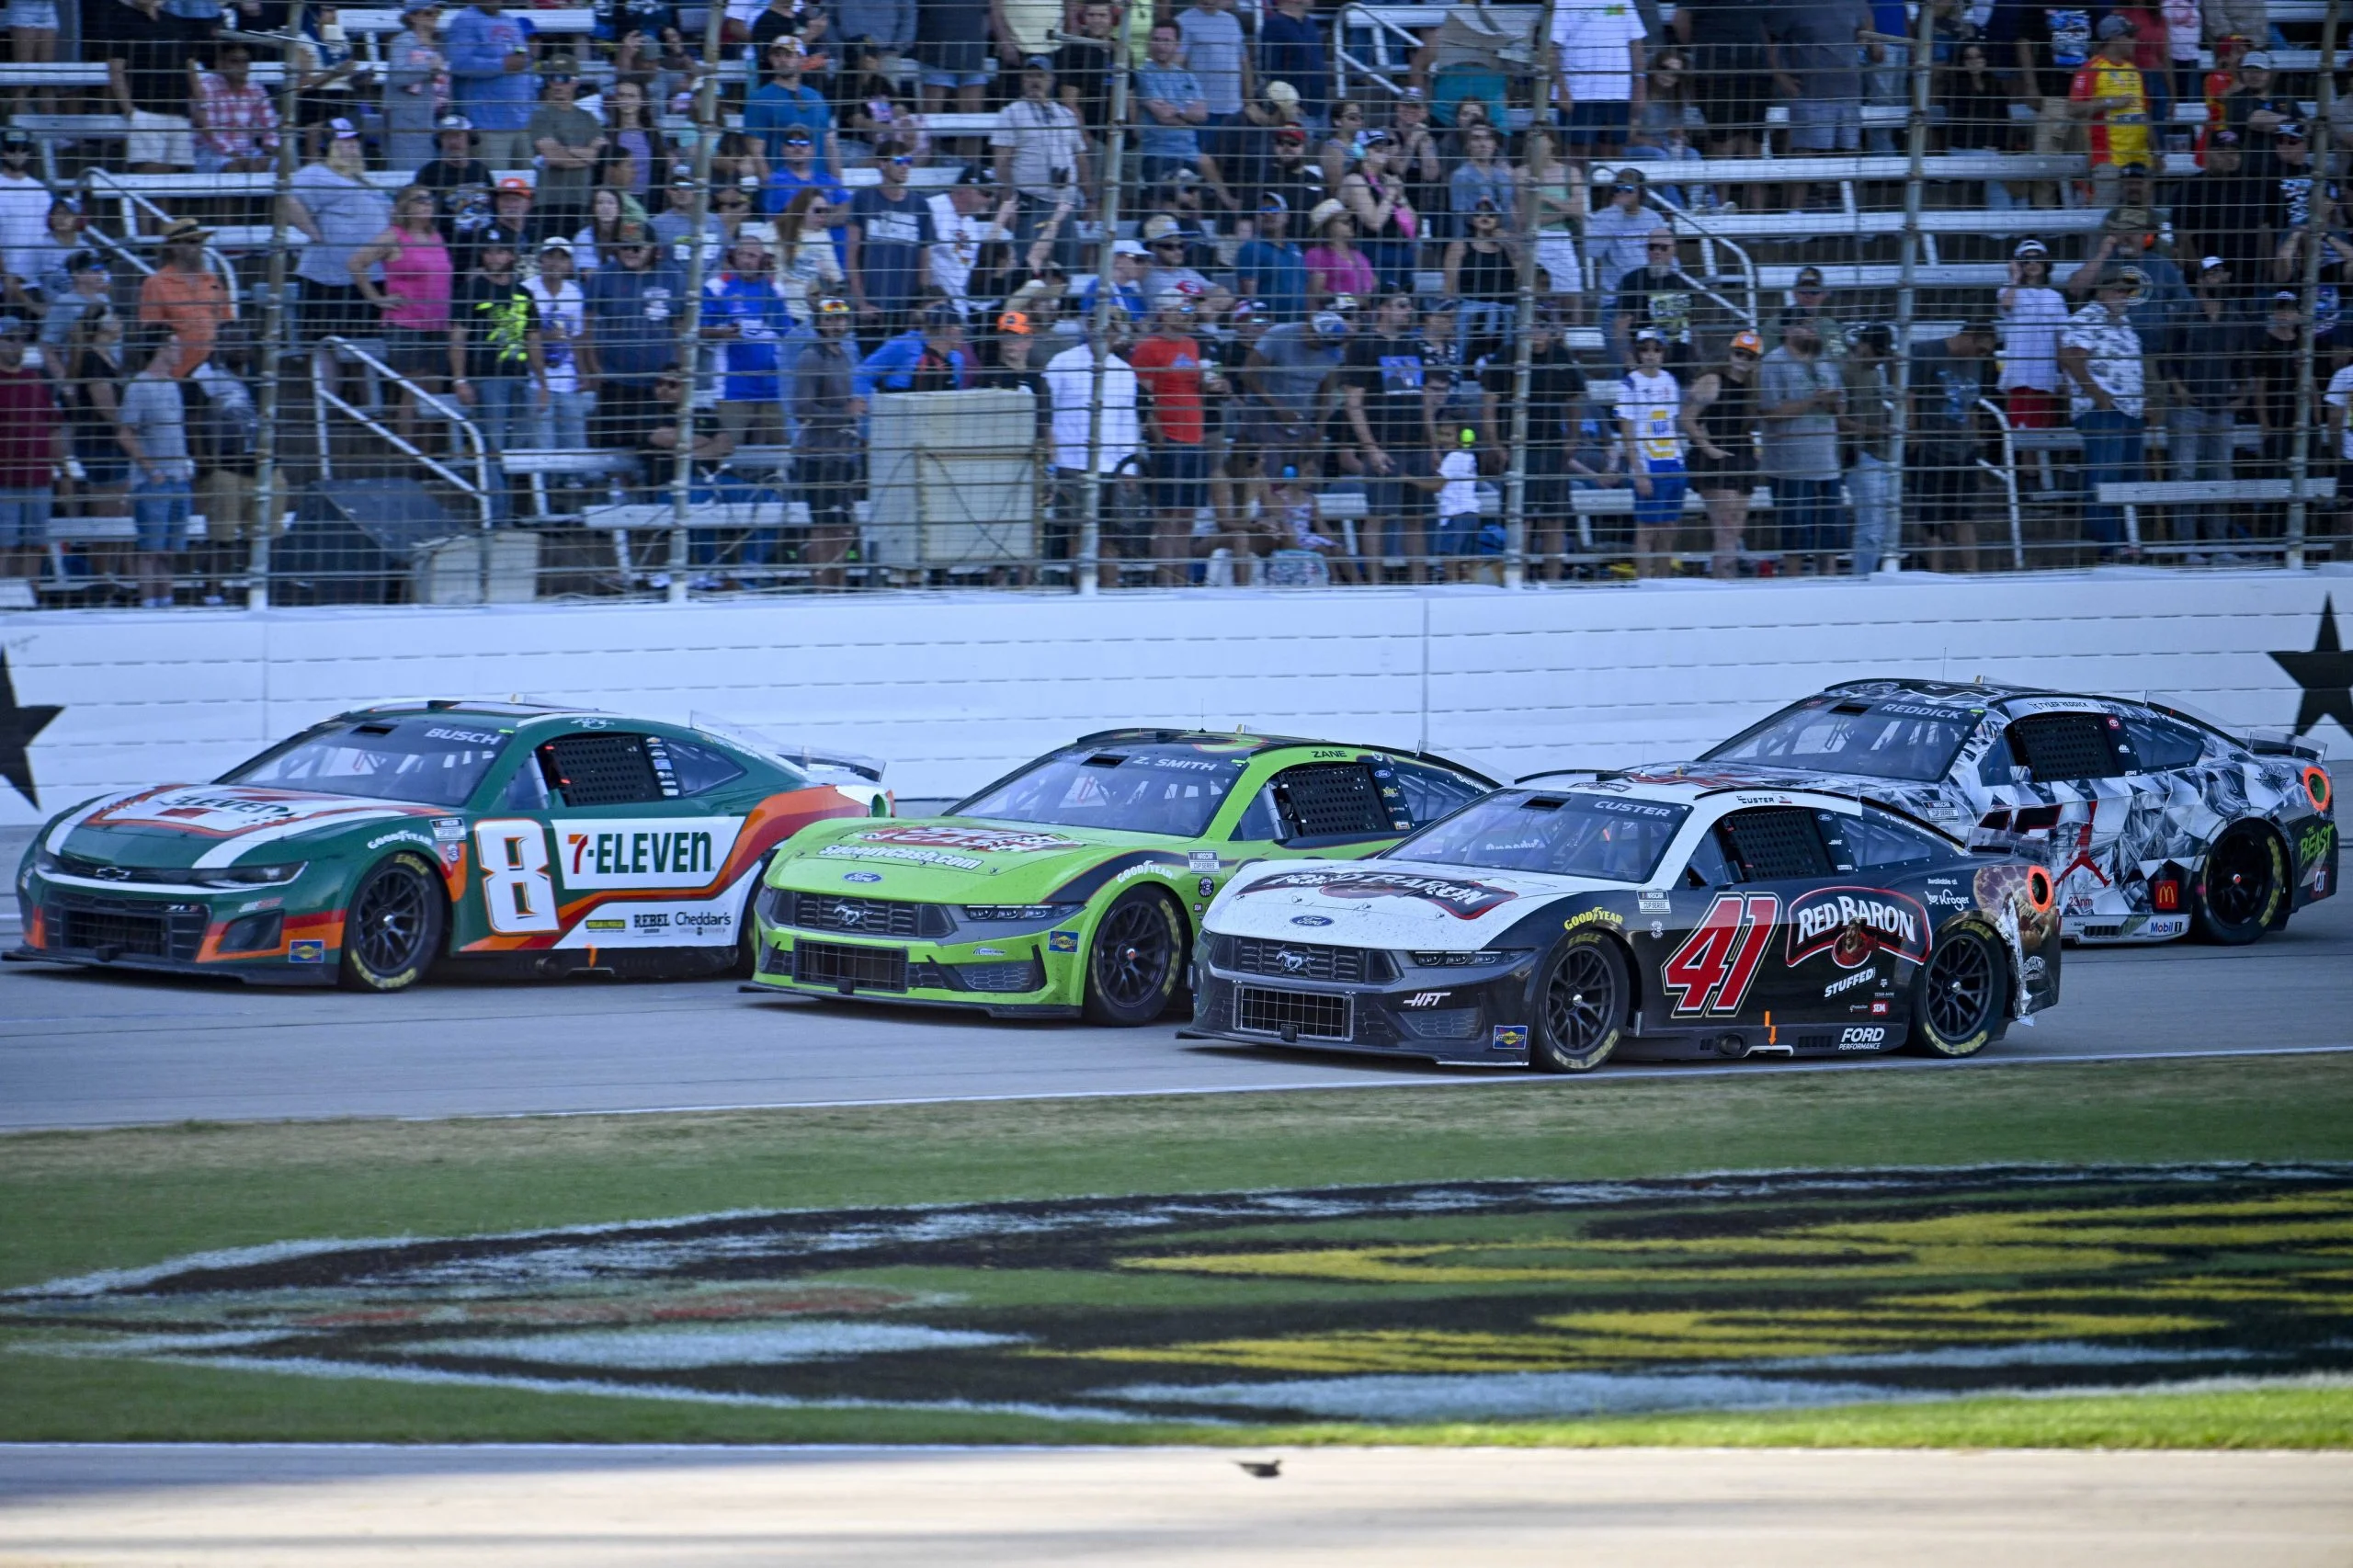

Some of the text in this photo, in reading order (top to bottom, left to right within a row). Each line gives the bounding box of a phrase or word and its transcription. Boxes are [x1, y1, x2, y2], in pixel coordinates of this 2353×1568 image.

[1881, 703, 1964, 720] REDDICK
[424, 727, 501, 745] BUSCH
[1311, 749, 1347, 758] ZANE
[1132, 756, 1218, 771] Z. SMITH
[1738, 796, 1775, 804] CUSTER
[1594, 801, 1672, 817] CUSTER
[368, 830, 433, 849] GOODYEAR
[2301, 824, 2334, 865] BEAST
[473, 818, 561, 936] 8
[1117, 859, 1174, 882] GOODYEAR
[1939, 889, 1970, 911] Kroger
[634, 914, 671, 927] REBEL
[675, 912, 732, 926] Cheddar's
[1563, 906, 1624, 930] GOODYEAR
[1797, 895, 1915, 945] RED BARON
[2150, 921, 2183, 933] Mobil 1
[1050, 937, 1078, 947] SUNOCO
[1663, 895, 1779, 1012] 41
[1824, 968, 1874, 998] STUFFED
[1872, 1004, 1886, 1012] SEM
[1495, 1034, 1524, 1042] SUNOCO
[1840, 1027, 1885, 1043] FORD
[1838, 1042, 1881, 1051] PERFORMANCE
